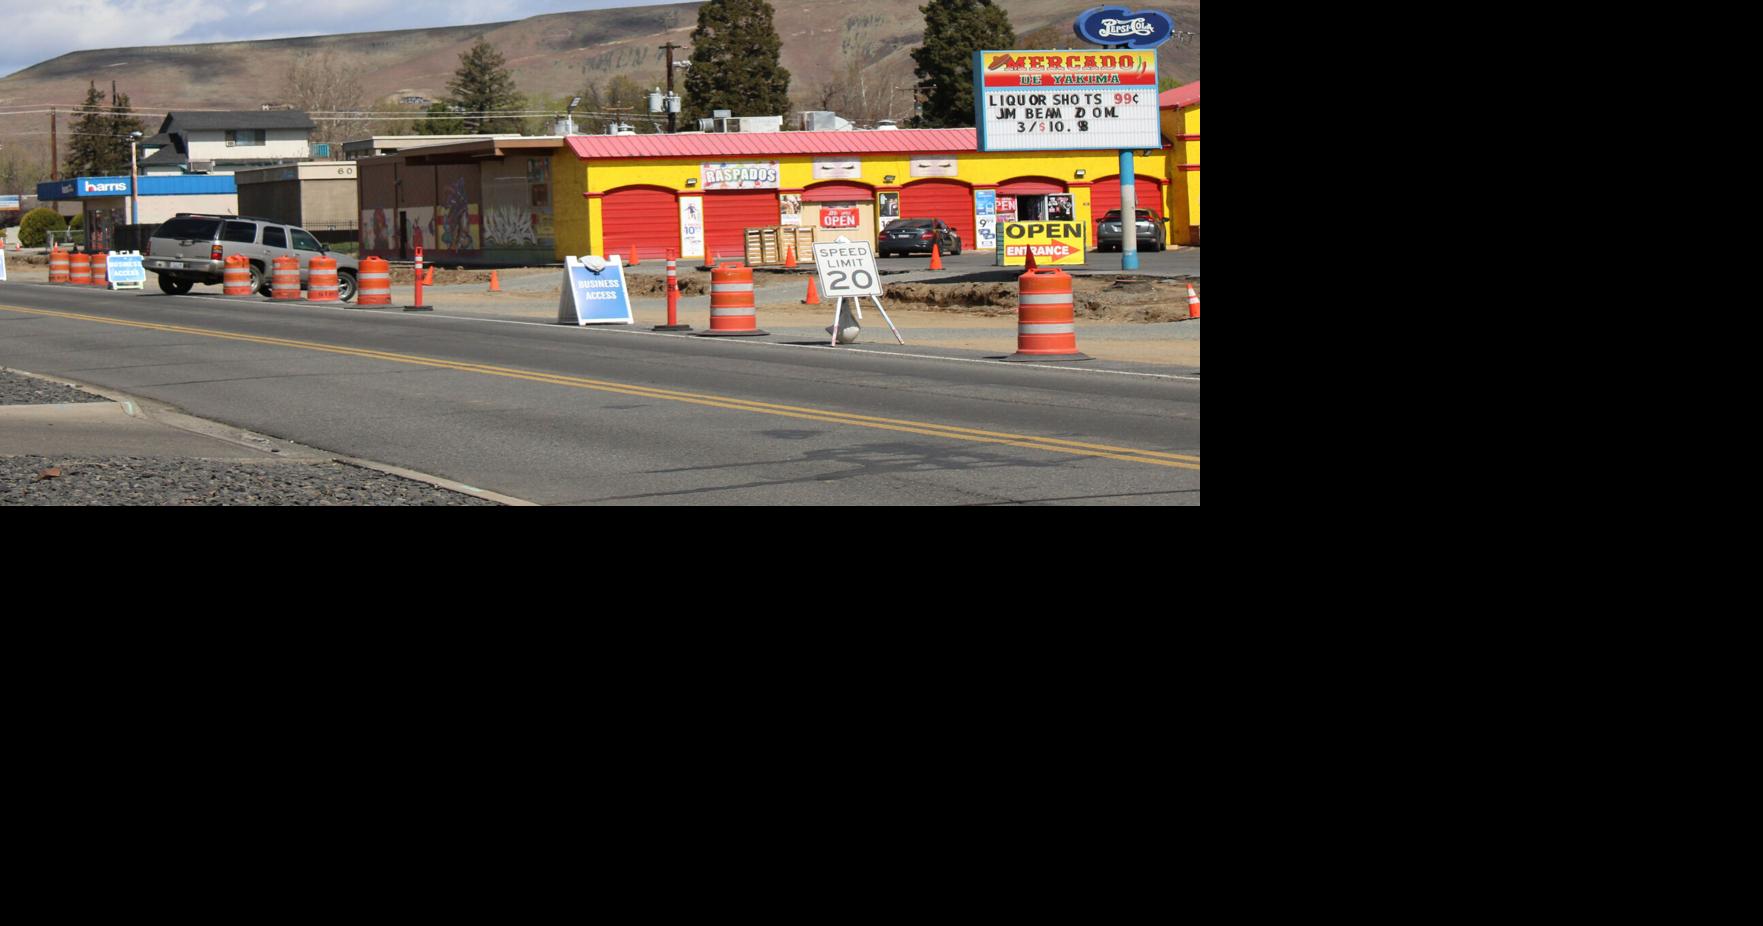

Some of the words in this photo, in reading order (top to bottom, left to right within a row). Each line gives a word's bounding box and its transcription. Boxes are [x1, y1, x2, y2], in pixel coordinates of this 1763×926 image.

[1004, 55, 1134, 71] MERCADO
[1019, 74, 1042, 85] DE
[1053, 73, 1120, 84] YAKIMA
[989, 94, 1047, 106] LIQUOR
[1053, 93, 1102, 105] SHOTS
[1025, 107, 1062, 119] BEAM
[705, 167, 776, 184] RASPADOS
[85, 181, 127, 192] harris
[996, 200, 1016, 211] PEN
[824, 215, 856, 226] OPEN
[1006, 223, 1082, 239] OPEN
[820, 247, 867, 258] SPEED
[828, 258, 863, 268] LIMIT
[578, 279, 620, 289] BUSINESS
[827, 269, 873, 290] 20
[586, 290, 617, 300] ACCESS
